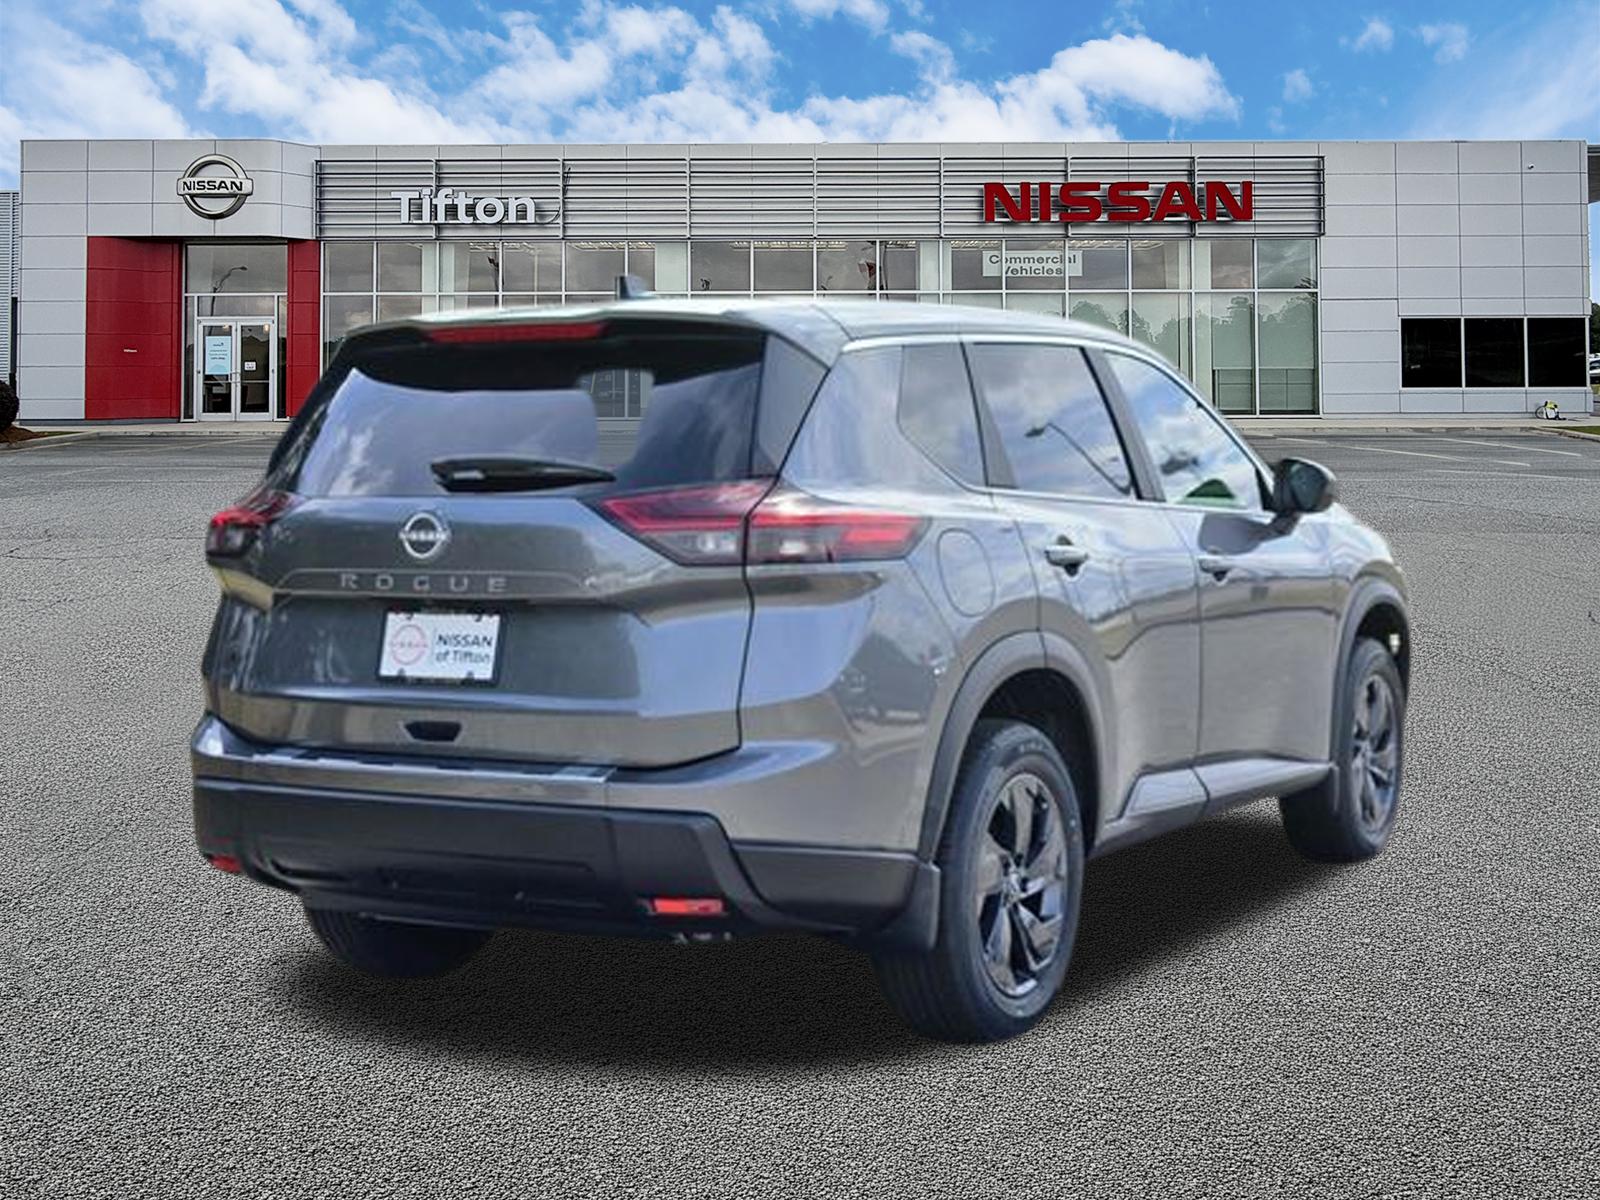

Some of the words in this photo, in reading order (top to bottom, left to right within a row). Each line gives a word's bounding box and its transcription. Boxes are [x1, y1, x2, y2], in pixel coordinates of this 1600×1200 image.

[183, 180, 243, 191] NISSAN
[391, 187, 536, 224] Tifton
[983, 180, 1254, 222] NISSAN
[340, 573, 508, 592] ROGUE
[437, 634, 493, 647] NISSAN
